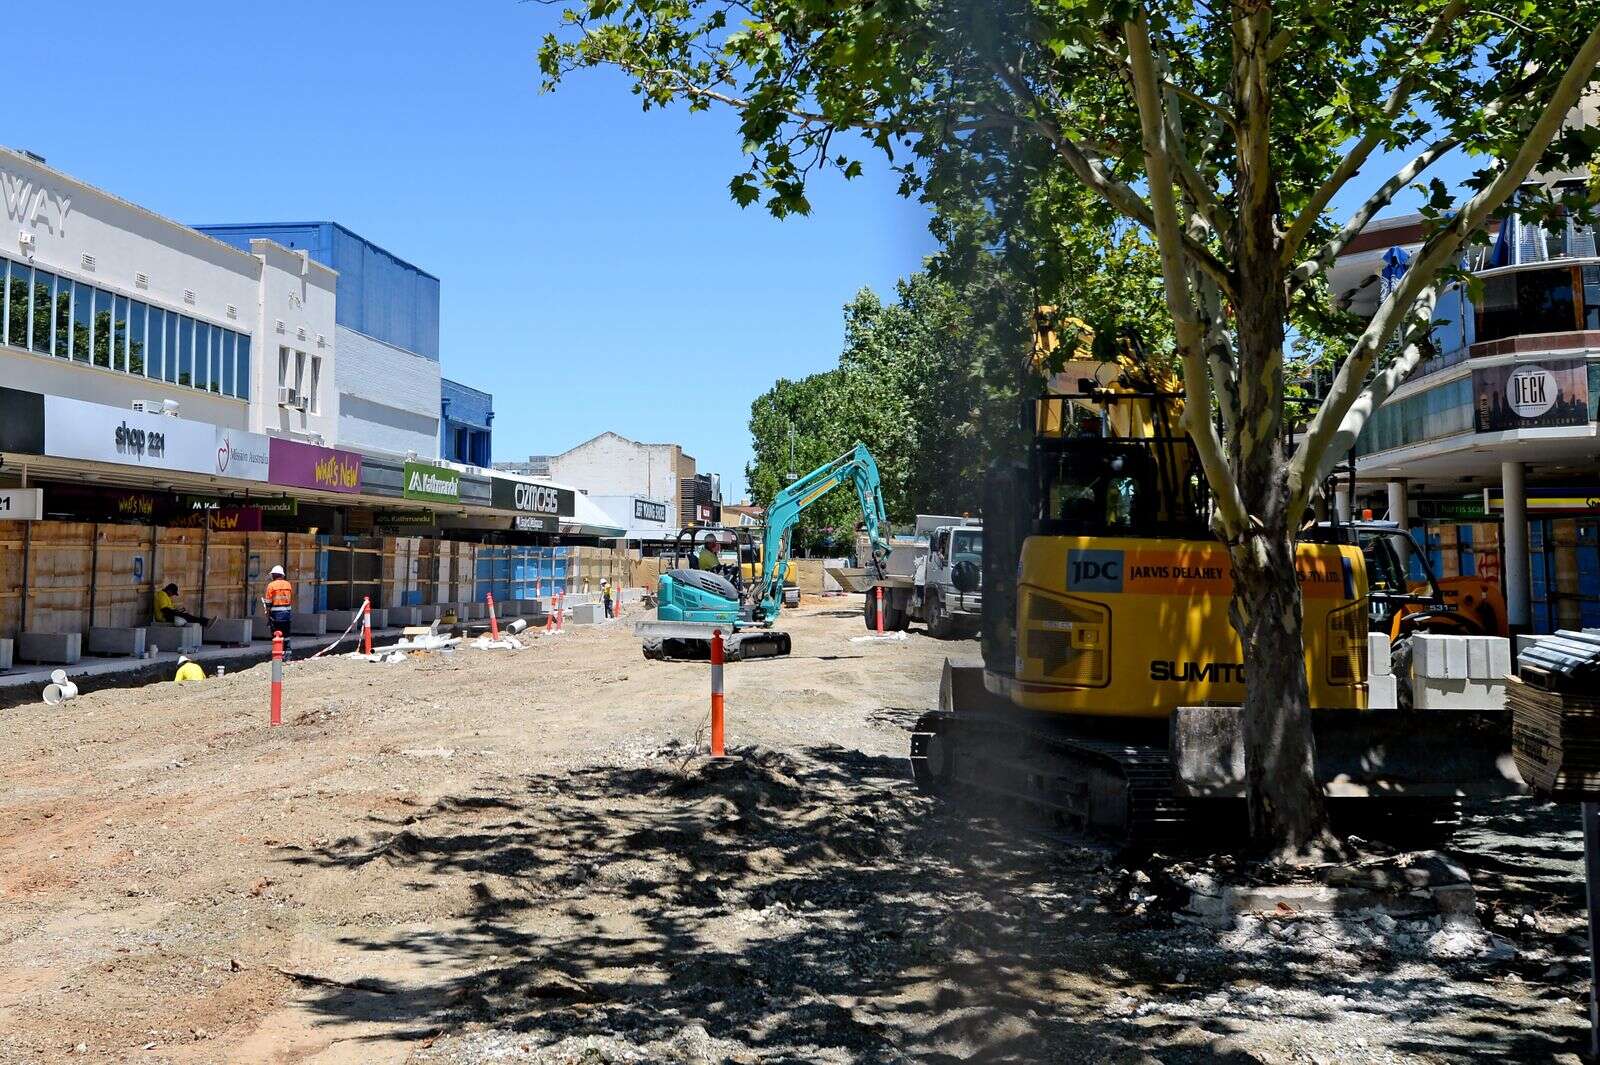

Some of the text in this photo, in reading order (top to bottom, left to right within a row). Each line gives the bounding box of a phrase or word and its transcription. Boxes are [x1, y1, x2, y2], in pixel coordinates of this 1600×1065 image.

[1514, 375, 1546, 404] DECK
[115, 420, 165, 454] shop 221
[422, 473, 457, 496] Kathmandu
[515, 483, 558, 513] OZMOSIS
[1072, 560, 1118, 584] JDC
[1130, 566, 1168, 580] JARVIS
[1172, 566, 1223, 580] DELAHEY
